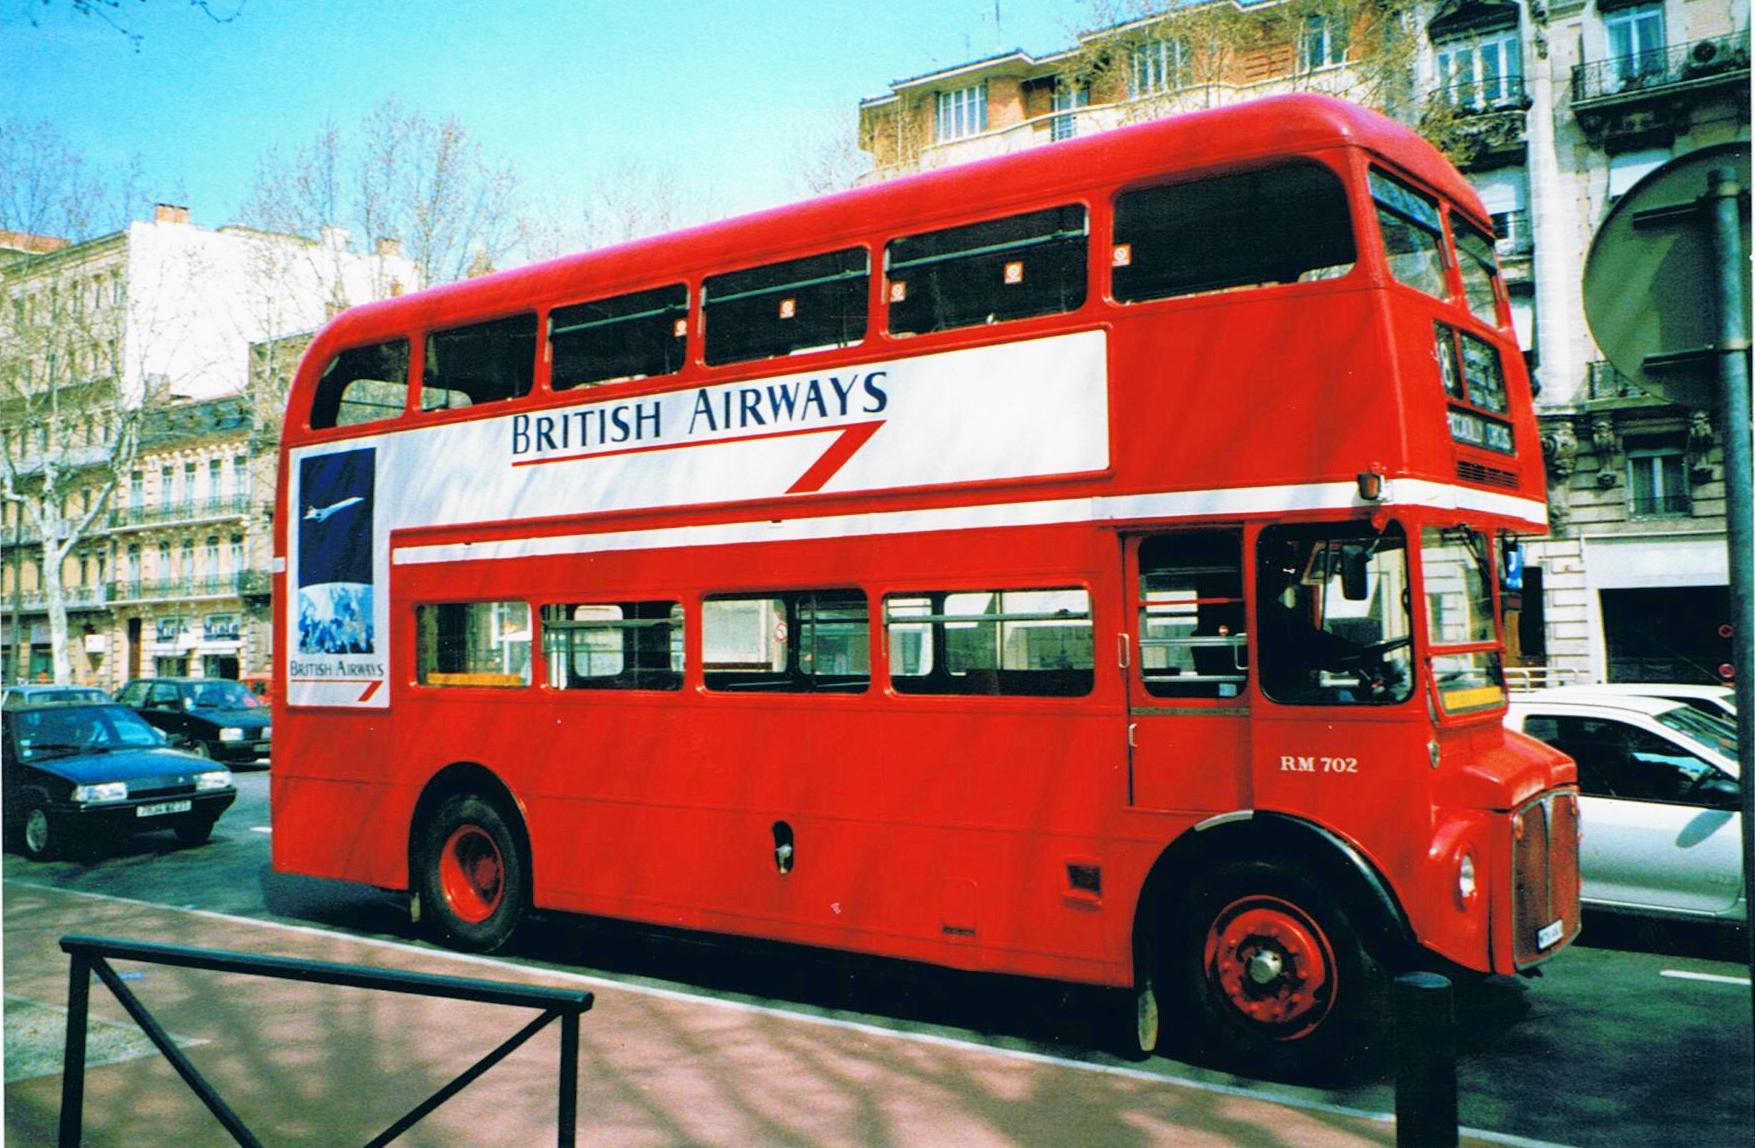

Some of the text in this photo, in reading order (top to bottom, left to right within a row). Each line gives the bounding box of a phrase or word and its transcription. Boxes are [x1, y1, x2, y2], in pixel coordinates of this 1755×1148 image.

[512, 370, 888, 456] BRITISH AIRWAYS
[290, 659, 385, 677] BRITISH AIRWAYS
[1280, 755, 1358, 773] RM 702
